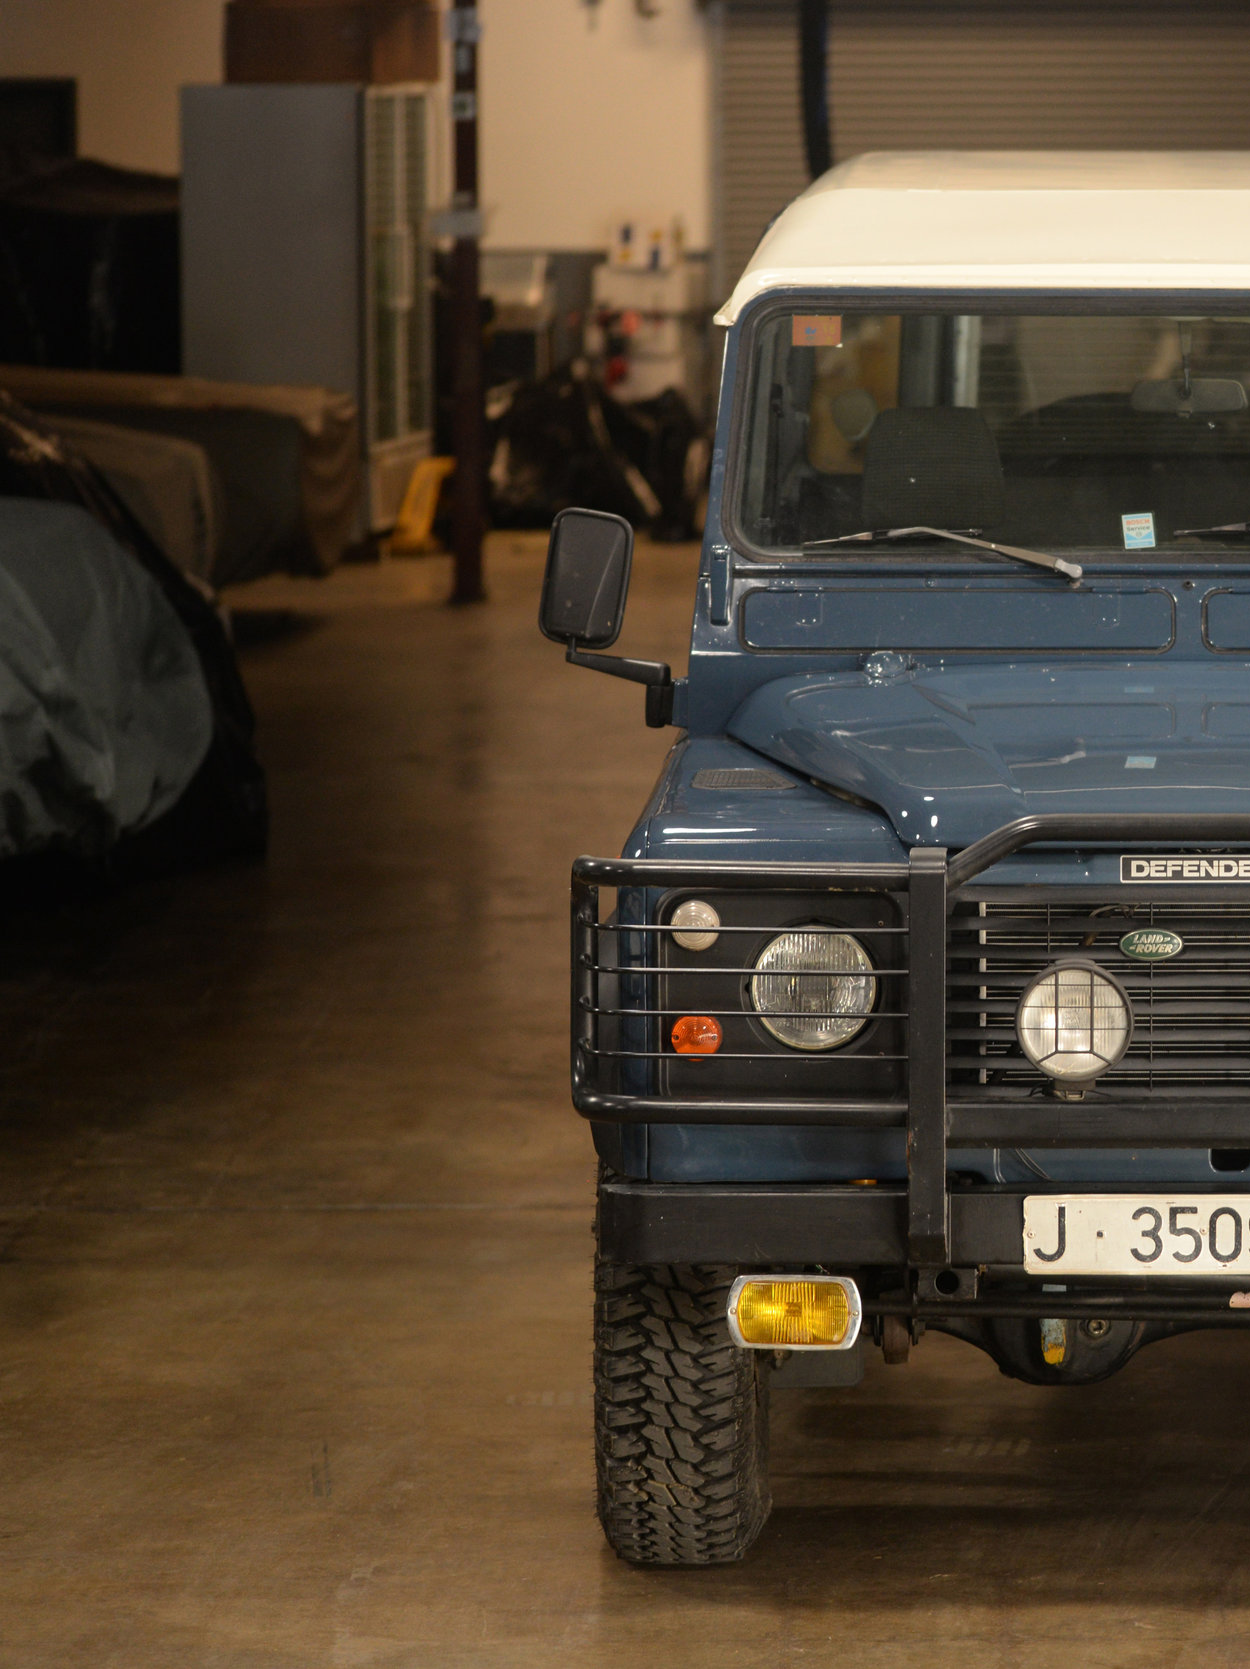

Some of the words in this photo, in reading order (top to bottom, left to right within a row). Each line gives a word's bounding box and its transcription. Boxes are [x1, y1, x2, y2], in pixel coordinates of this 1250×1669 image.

[1133, 934, 1164, 944] LAND
[1135, 943, 1174, 953] ROVER
[1033, 1206, 1066, 1262] J
